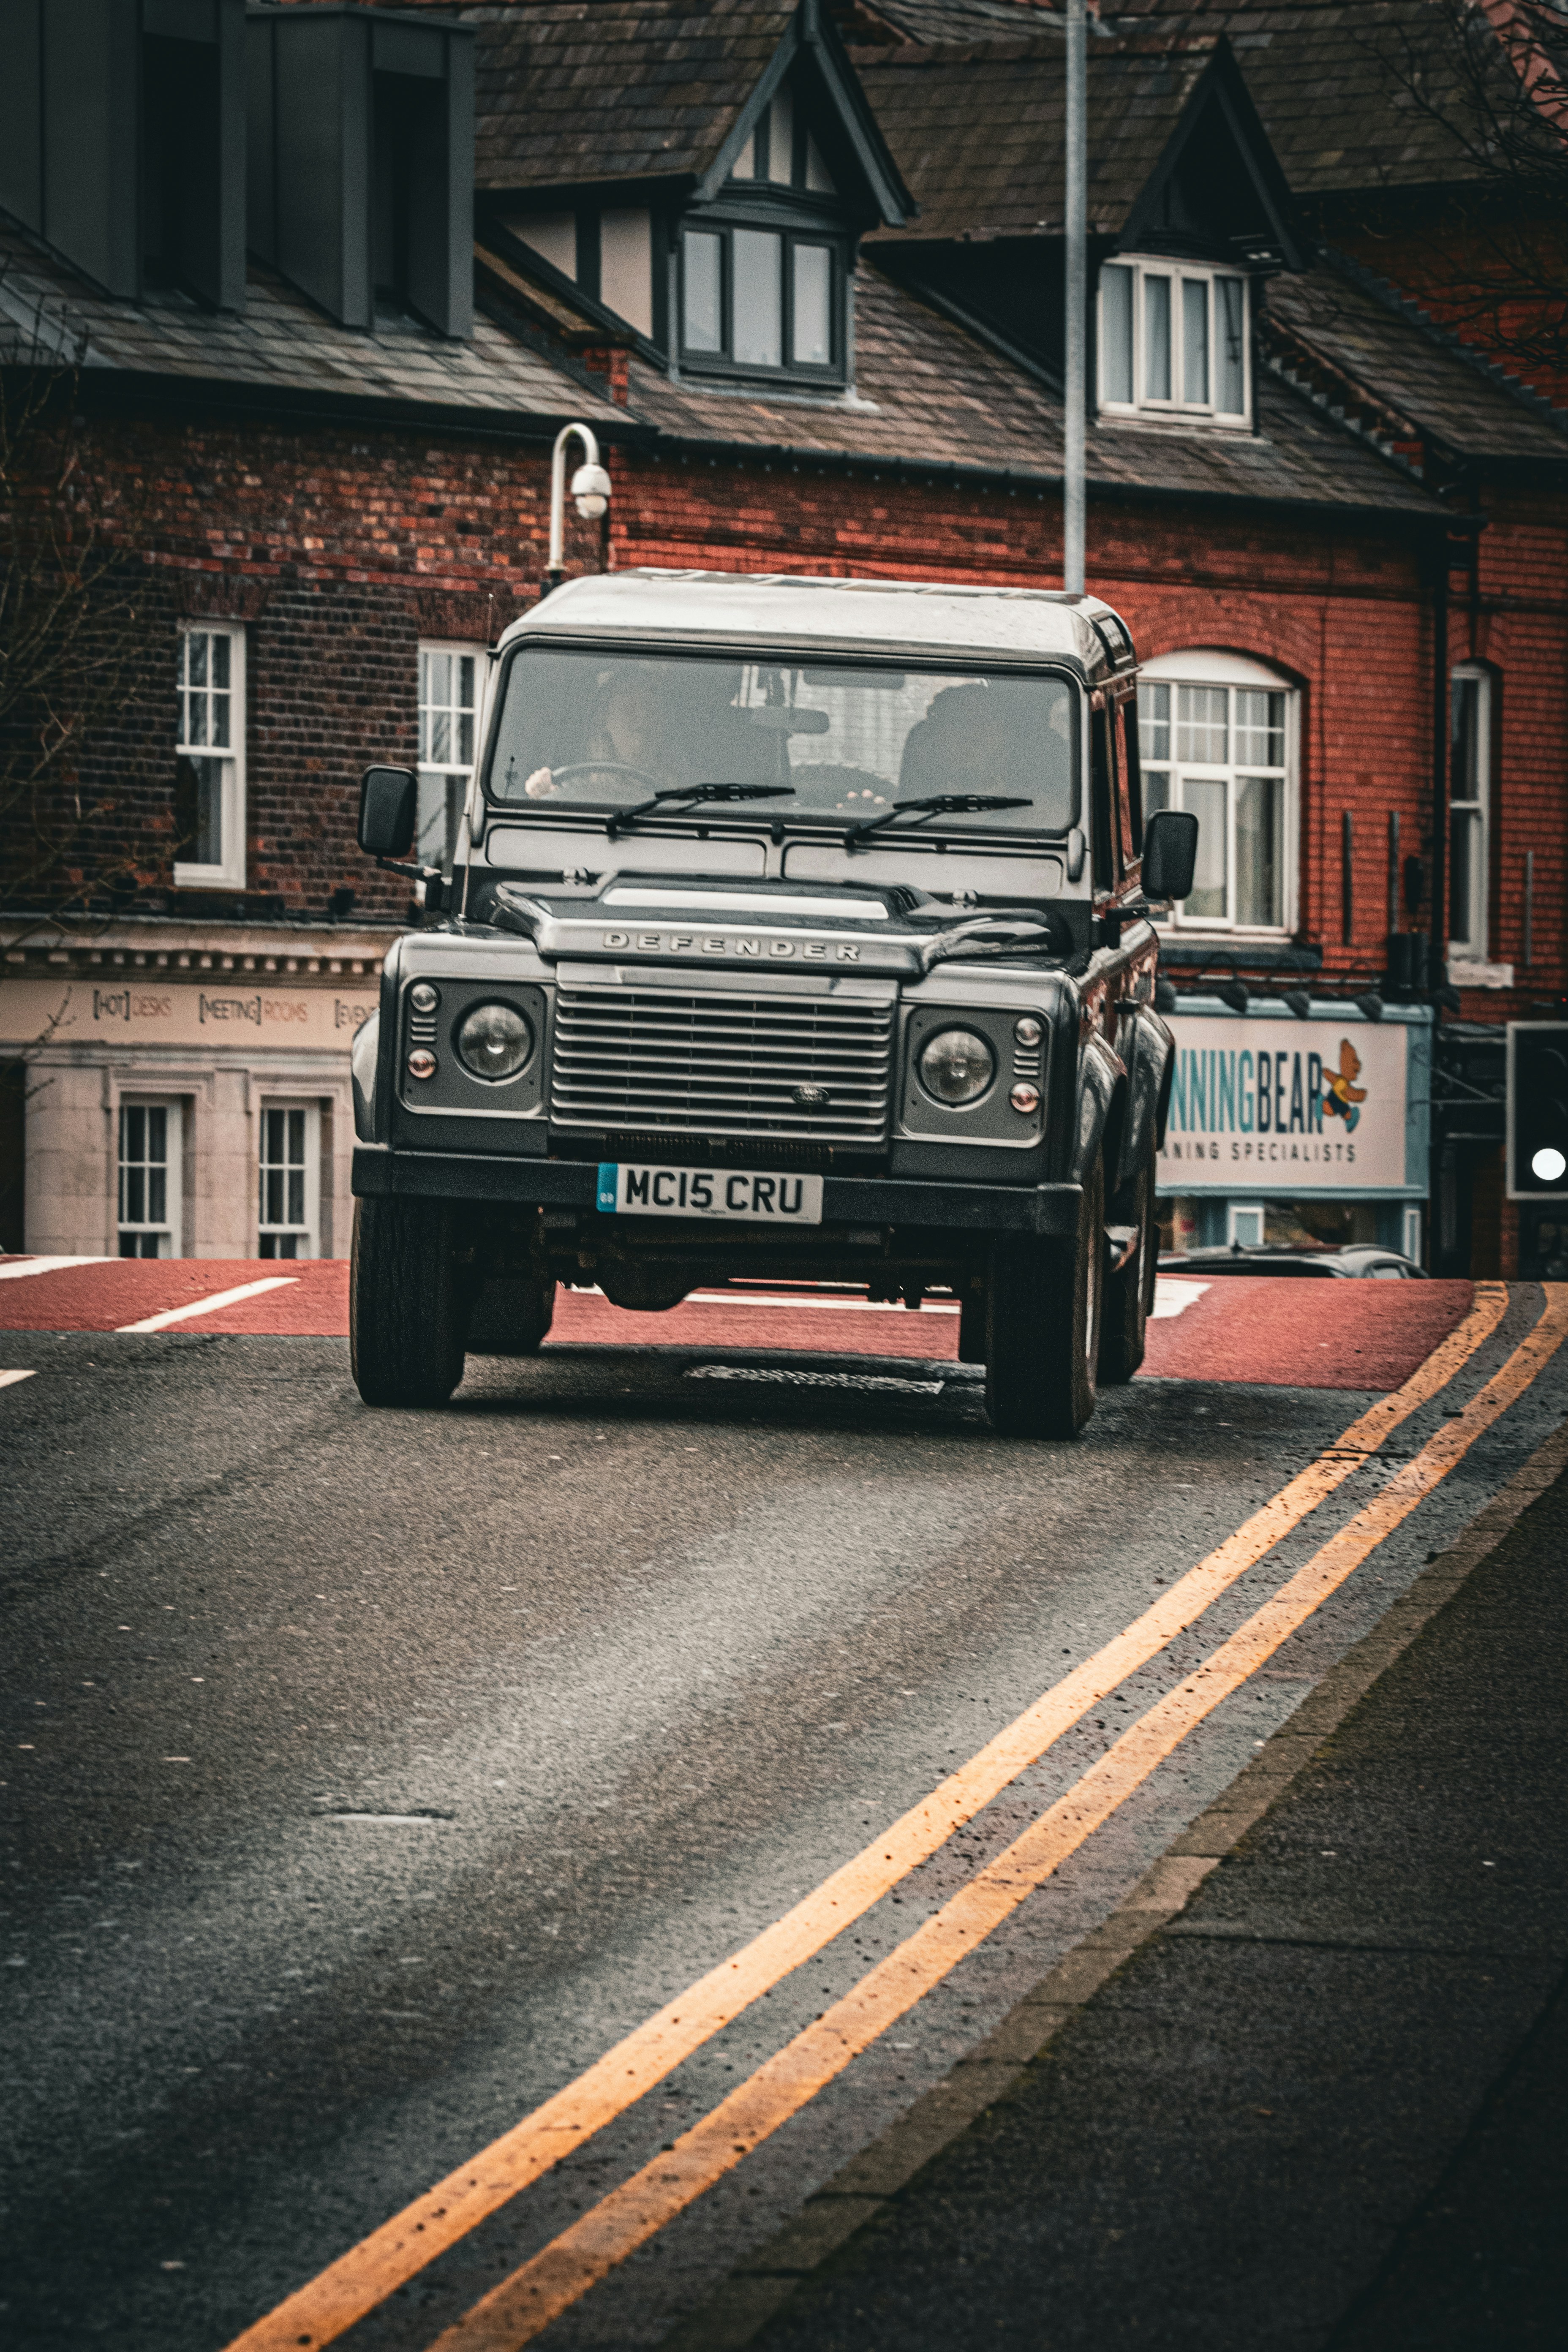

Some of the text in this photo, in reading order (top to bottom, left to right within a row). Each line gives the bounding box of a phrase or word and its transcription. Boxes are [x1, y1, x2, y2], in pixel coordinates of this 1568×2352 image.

[603, 931, 861, 961] DEFENDER
[1231, 1142, 1356, 1162] SPECIALISTS
[626, 1168, 803, 1214] MC15 CRU
